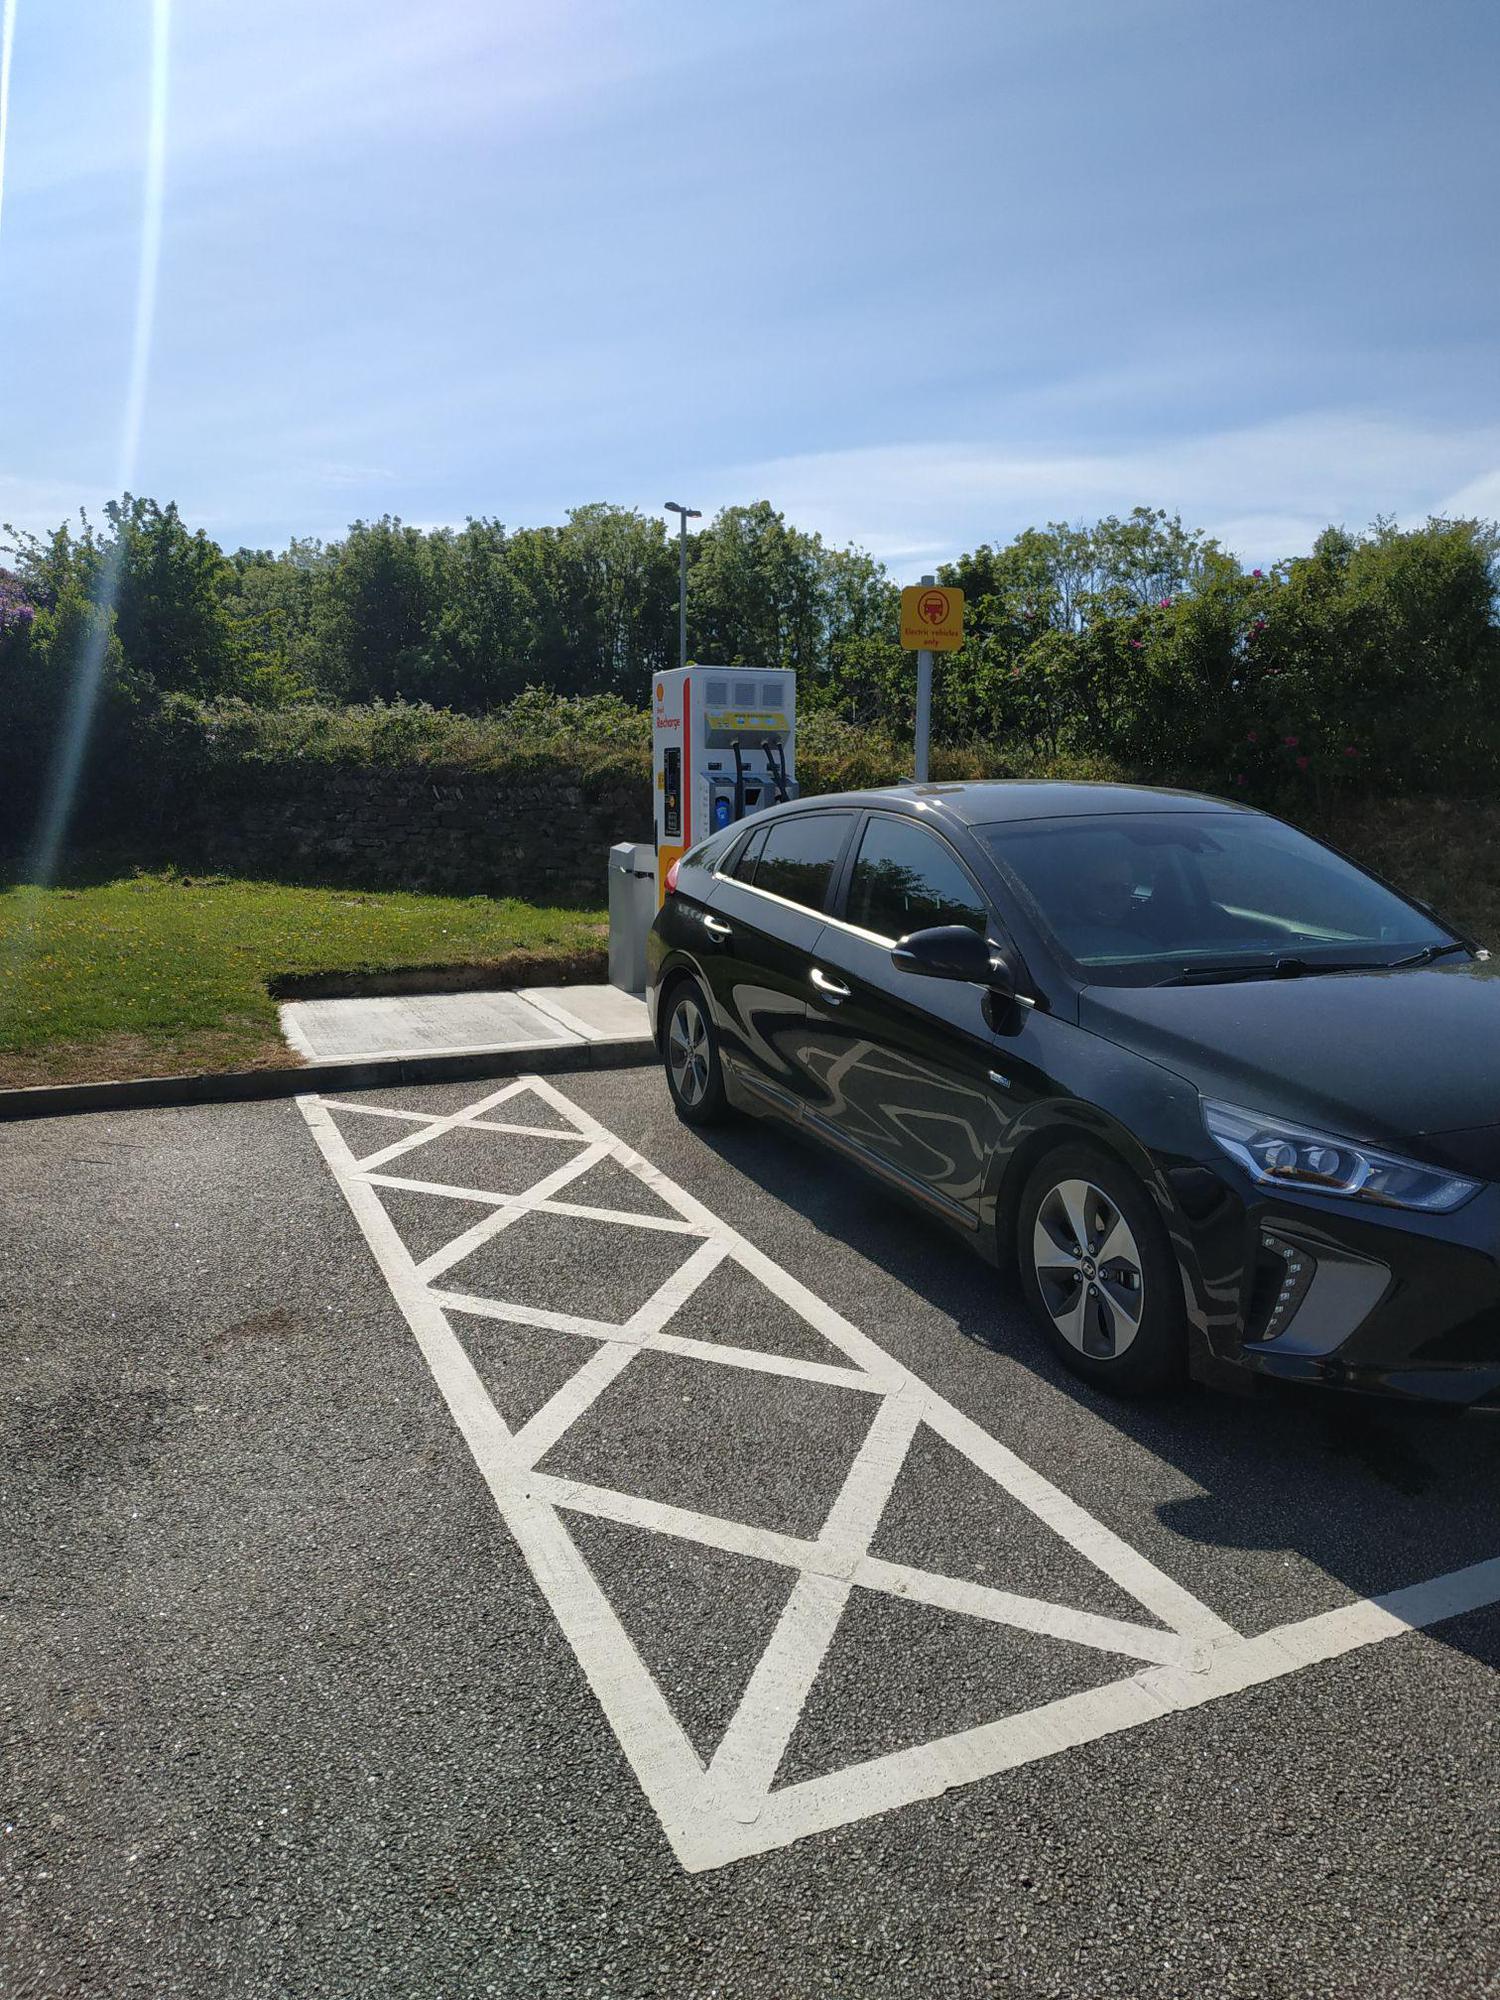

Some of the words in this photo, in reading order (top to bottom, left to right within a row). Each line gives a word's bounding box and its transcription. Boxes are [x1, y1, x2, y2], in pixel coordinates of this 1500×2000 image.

[905, 628, 928, 636] Electric
[931, 628, 958, 637] vehicles
[924, 639, 938, 648] only
[656, 716, 681, 730] Recharge
